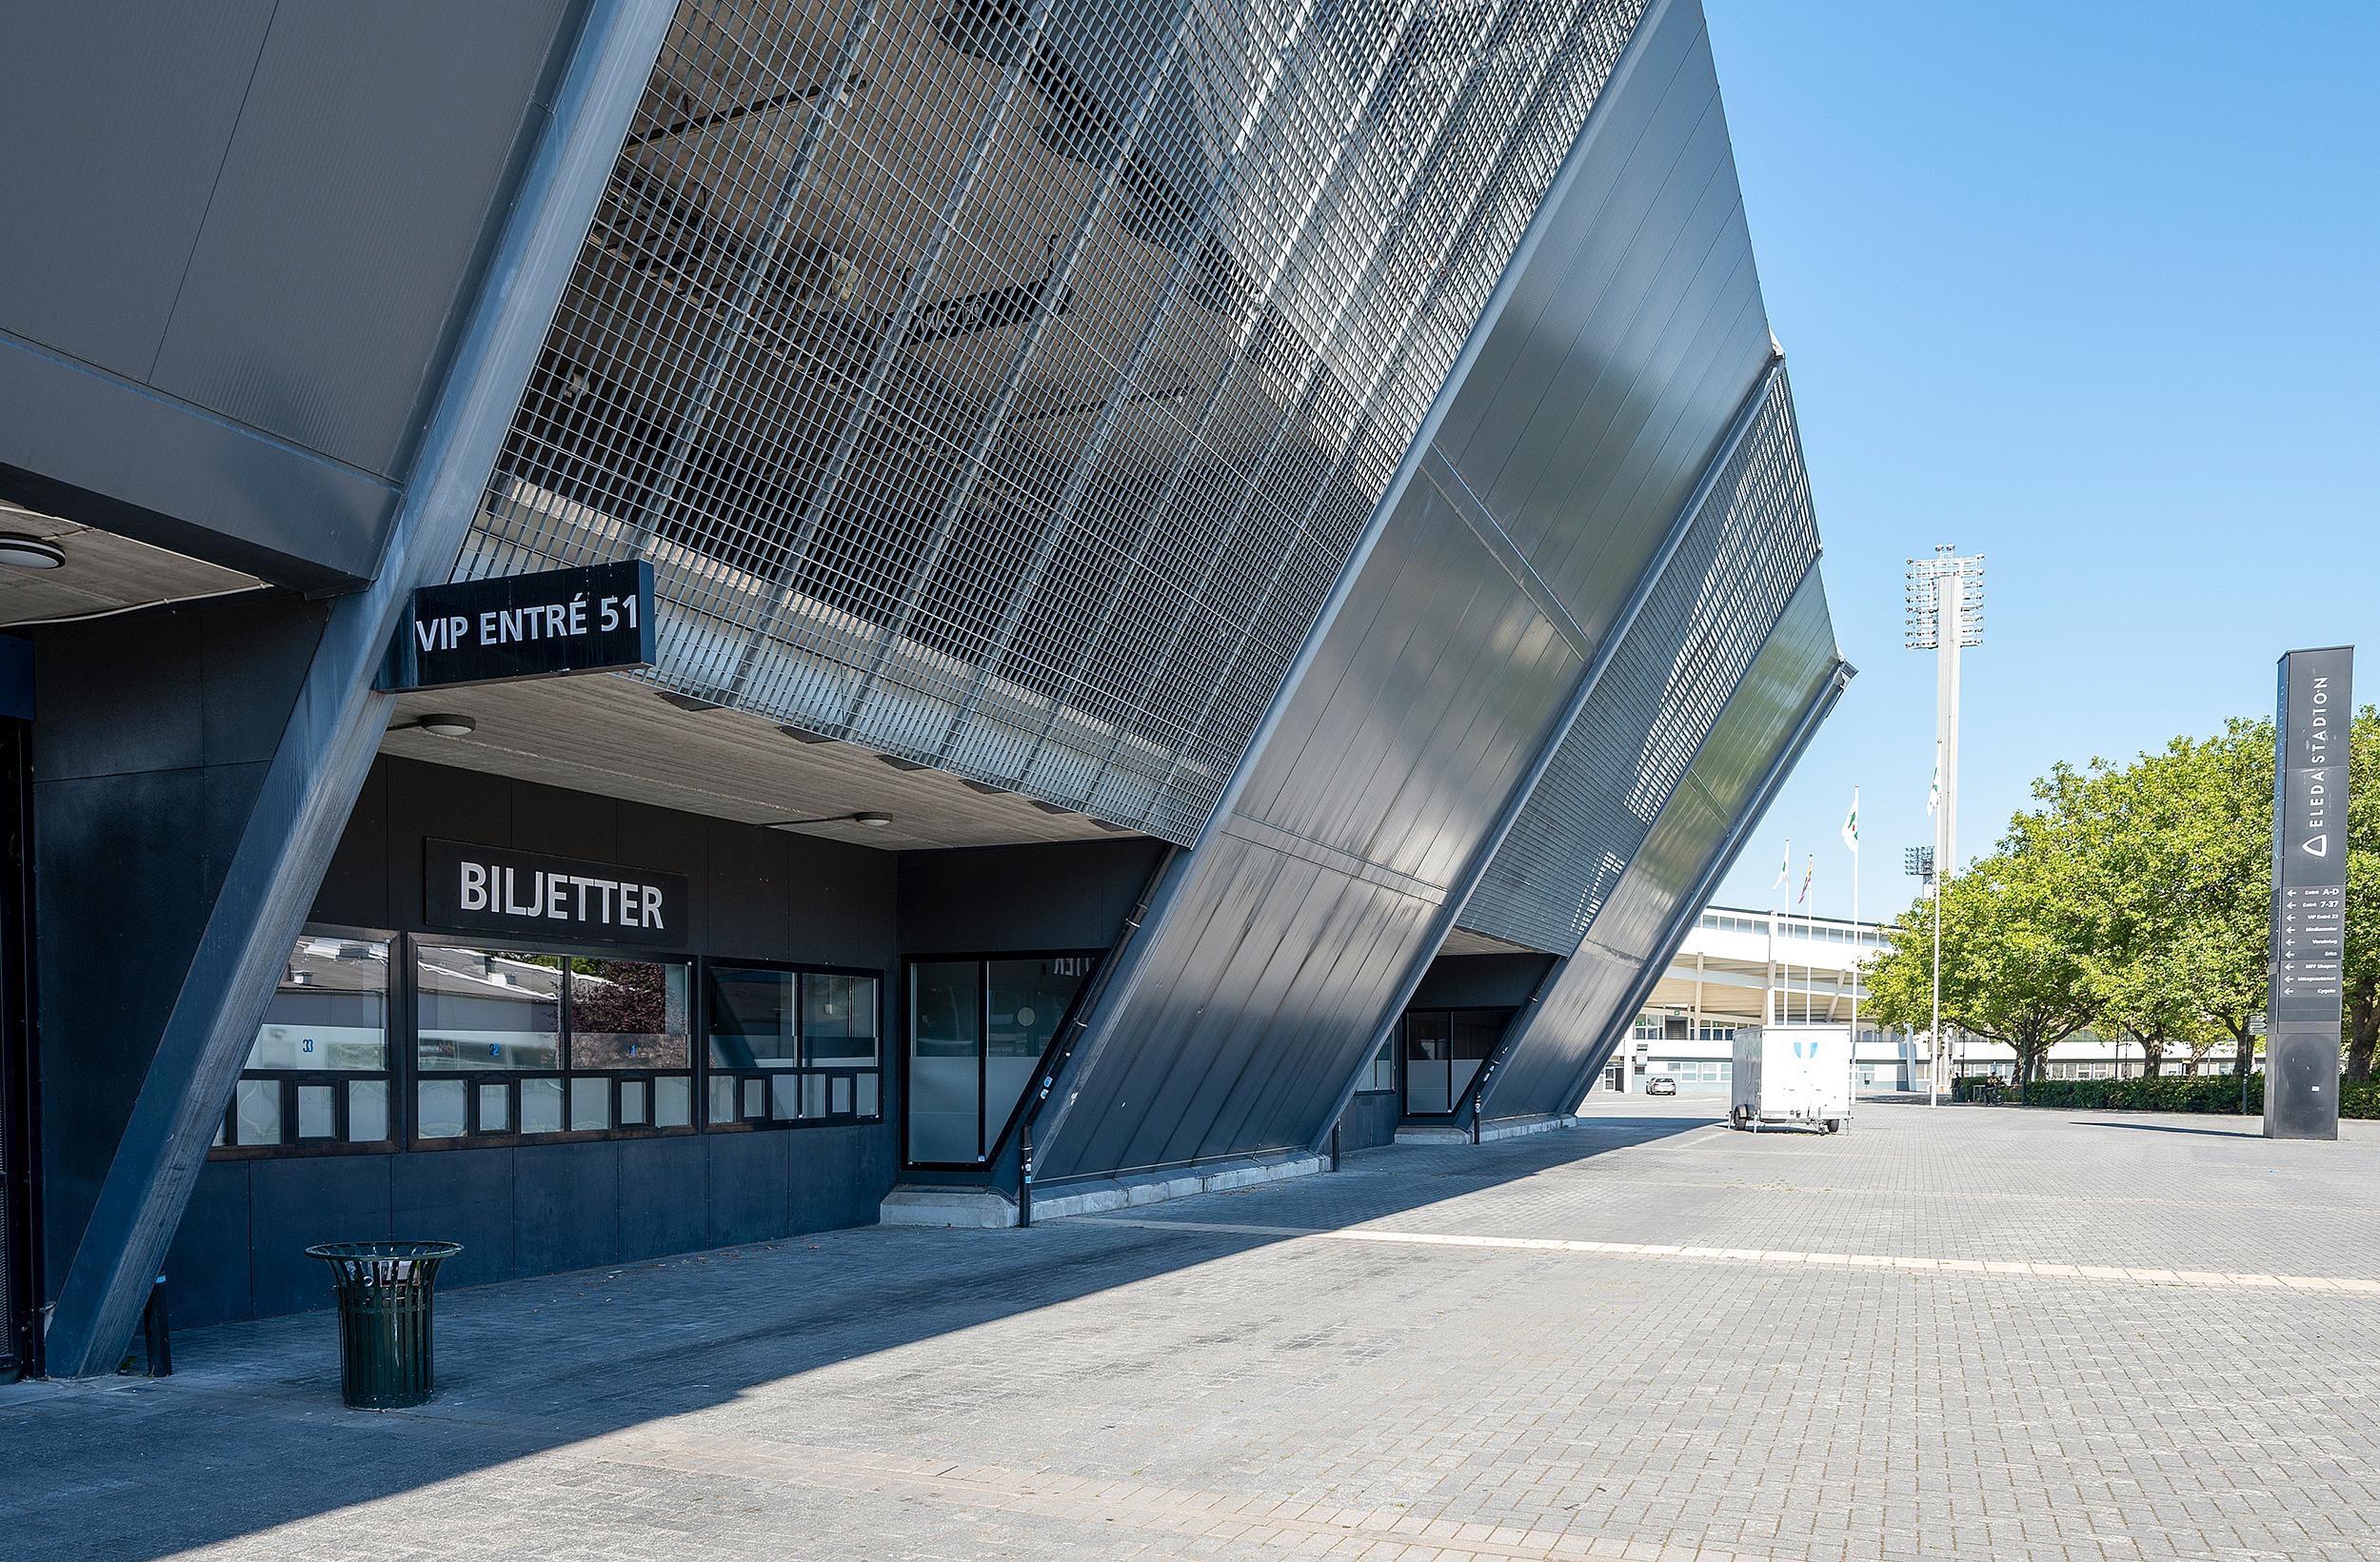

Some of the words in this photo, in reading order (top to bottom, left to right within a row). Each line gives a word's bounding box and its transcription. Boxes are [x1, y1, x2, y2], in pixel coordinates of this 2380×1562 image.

[416, 616, 468, 652] VIP
[480, 592, 587, 645] ENTRÉ
[601, 594, 637, 632] 51
[2311, 676, 2329, 763] STADION
[2309, 770, 2326, 827] ELEDA
[460, 860, 664, 929] BILJETTER
[2320, 900, 2339, 908] 7-37
[2322, 887, 2340, 896] A-D
